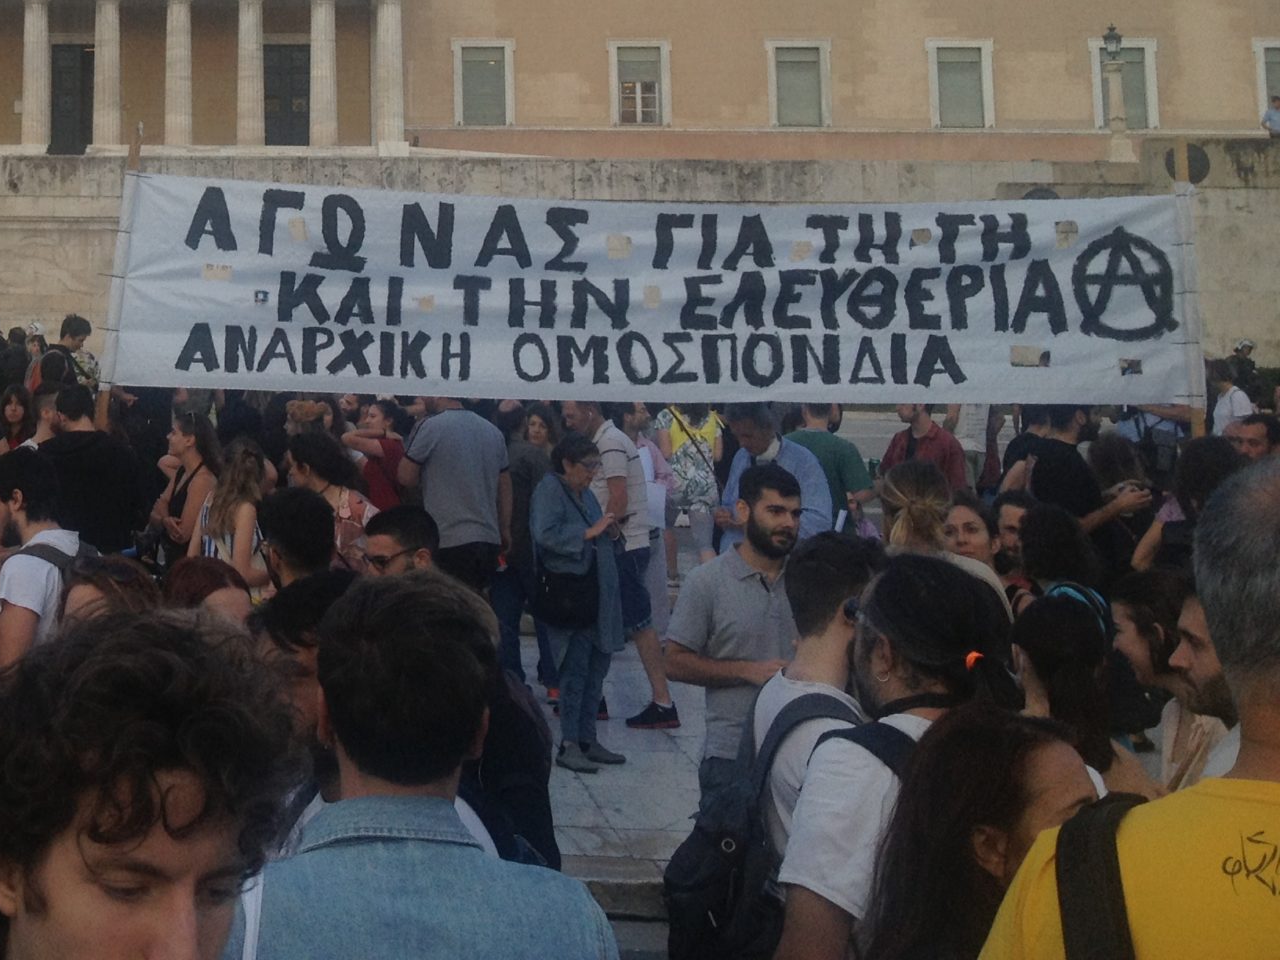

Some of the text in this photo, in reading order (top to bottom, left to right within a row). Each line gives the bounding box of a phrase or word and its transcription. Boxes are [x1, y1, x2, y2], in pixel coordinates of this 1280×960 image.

[184, 186, 1032, 273] ΑΓΩΝΑΣ ΓΙΑ ΤΗ ΓΗ
[277, 258, 1069, 337] ΚΑΙ ΤΗΝ ΕΛΕΥΘΕΡΙΑ
[175, 322, 968, 388] ΑΝΑΡΧΙΚΗ ΟΜΟΣΠΟΝΔΙΑ
